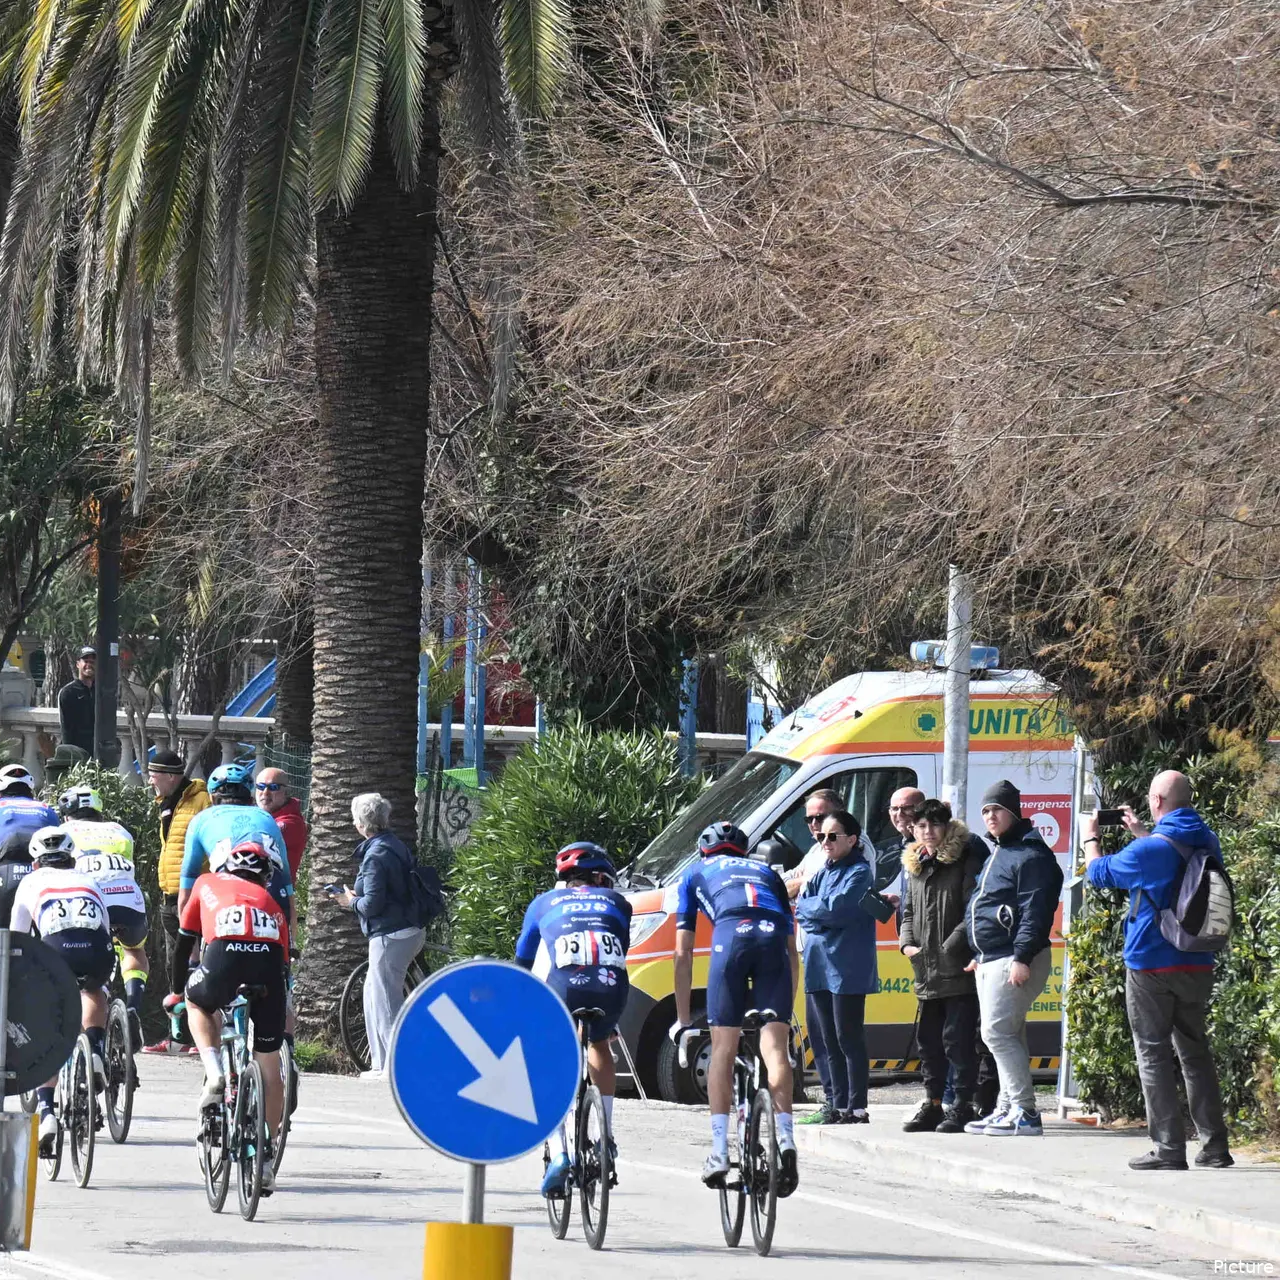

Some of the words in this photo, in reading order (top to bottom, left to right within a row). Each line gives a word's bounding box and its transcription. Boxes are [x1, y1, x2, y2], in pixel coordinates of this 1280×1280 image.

[1019, 801, 1072, 811] mergenza
[1038, 826, 1054, 837] 12
[107, 855, 132, 872] 115
[550, 894, 616, 906] Groupama
[79, 900, 97, 919] 23
[562, 902, 592, 914] FDJ
[225, 942, 270, 952] ARKEA
[601, 934, 622, 957] 95
